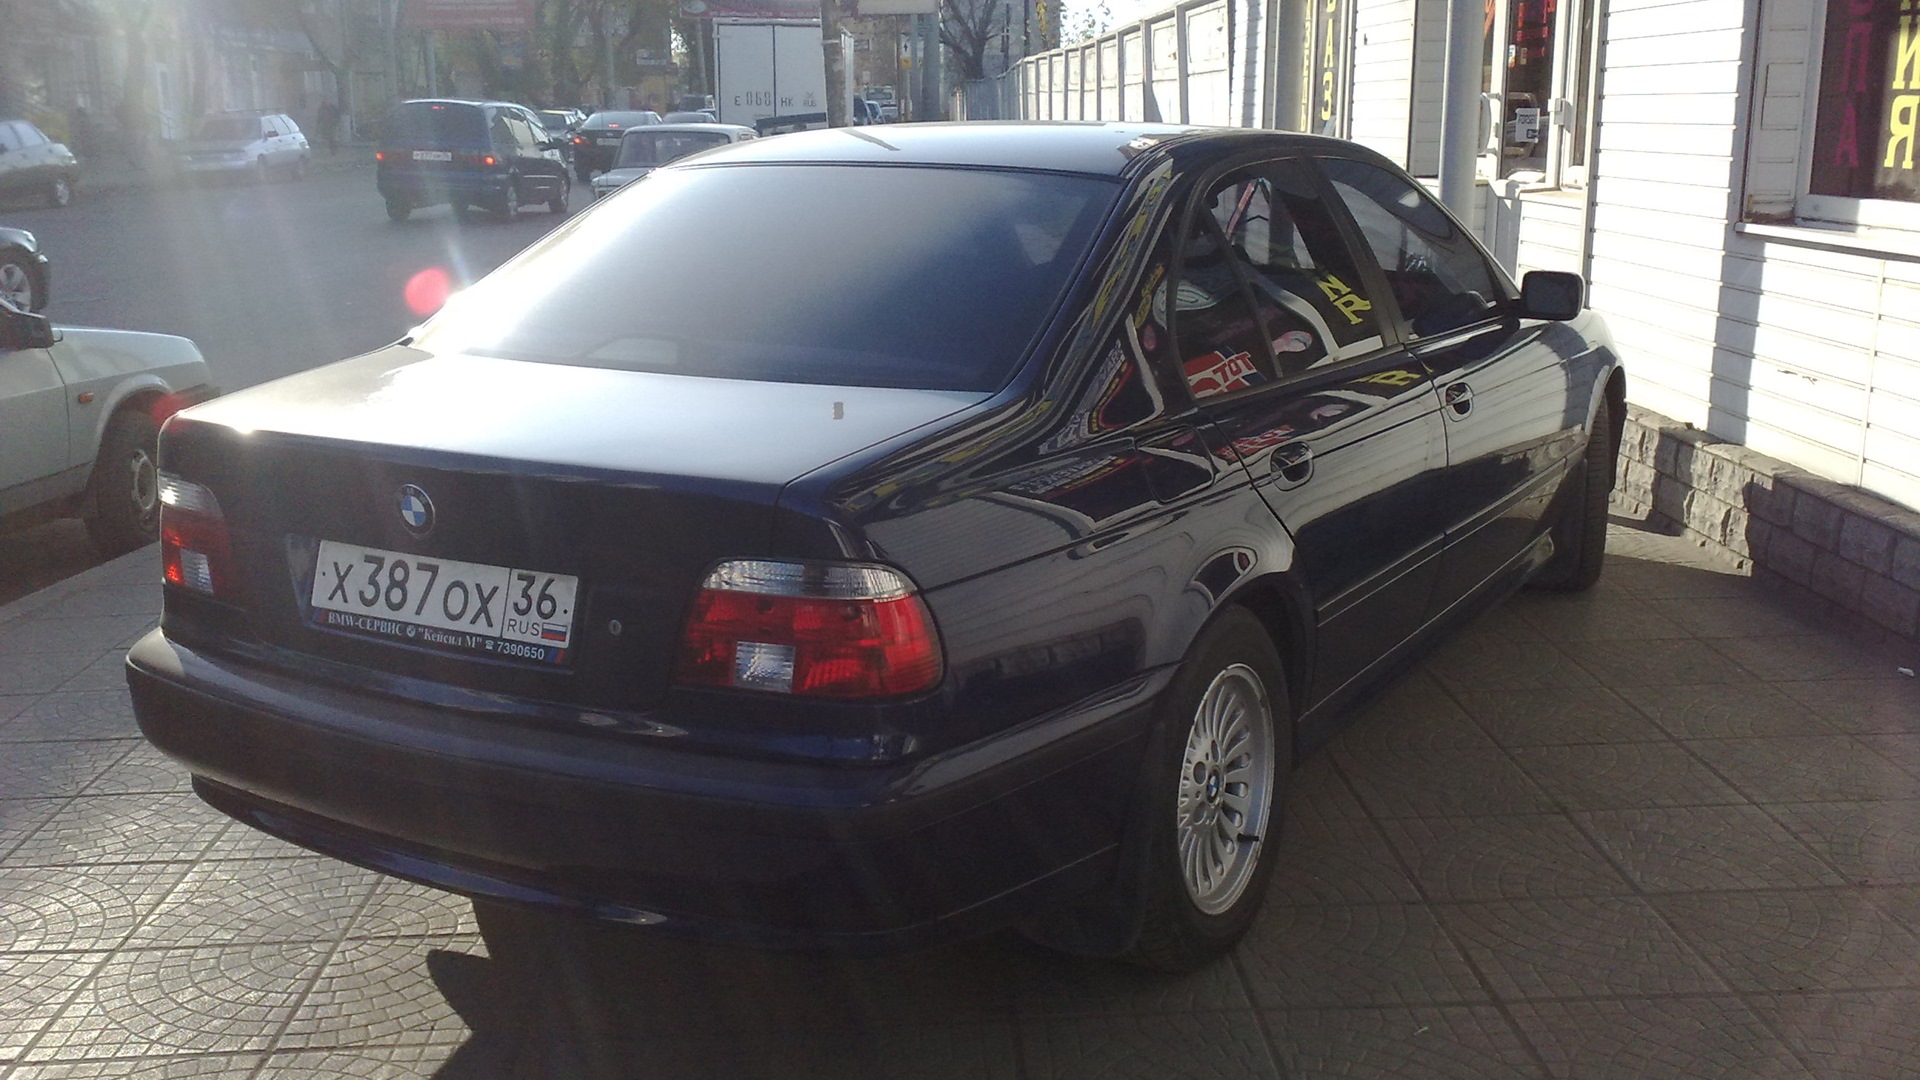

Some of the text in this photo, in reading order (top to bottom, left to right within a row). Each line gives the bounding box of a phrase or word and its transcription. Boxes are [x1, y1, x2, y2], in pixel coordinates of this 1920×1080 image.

[1321, 0, 1337, 121] АЗ
[512, 574, 557, 620] 36
[506, 618, 540, 636] RUS
[497, 641, 544, 660] 7390650
